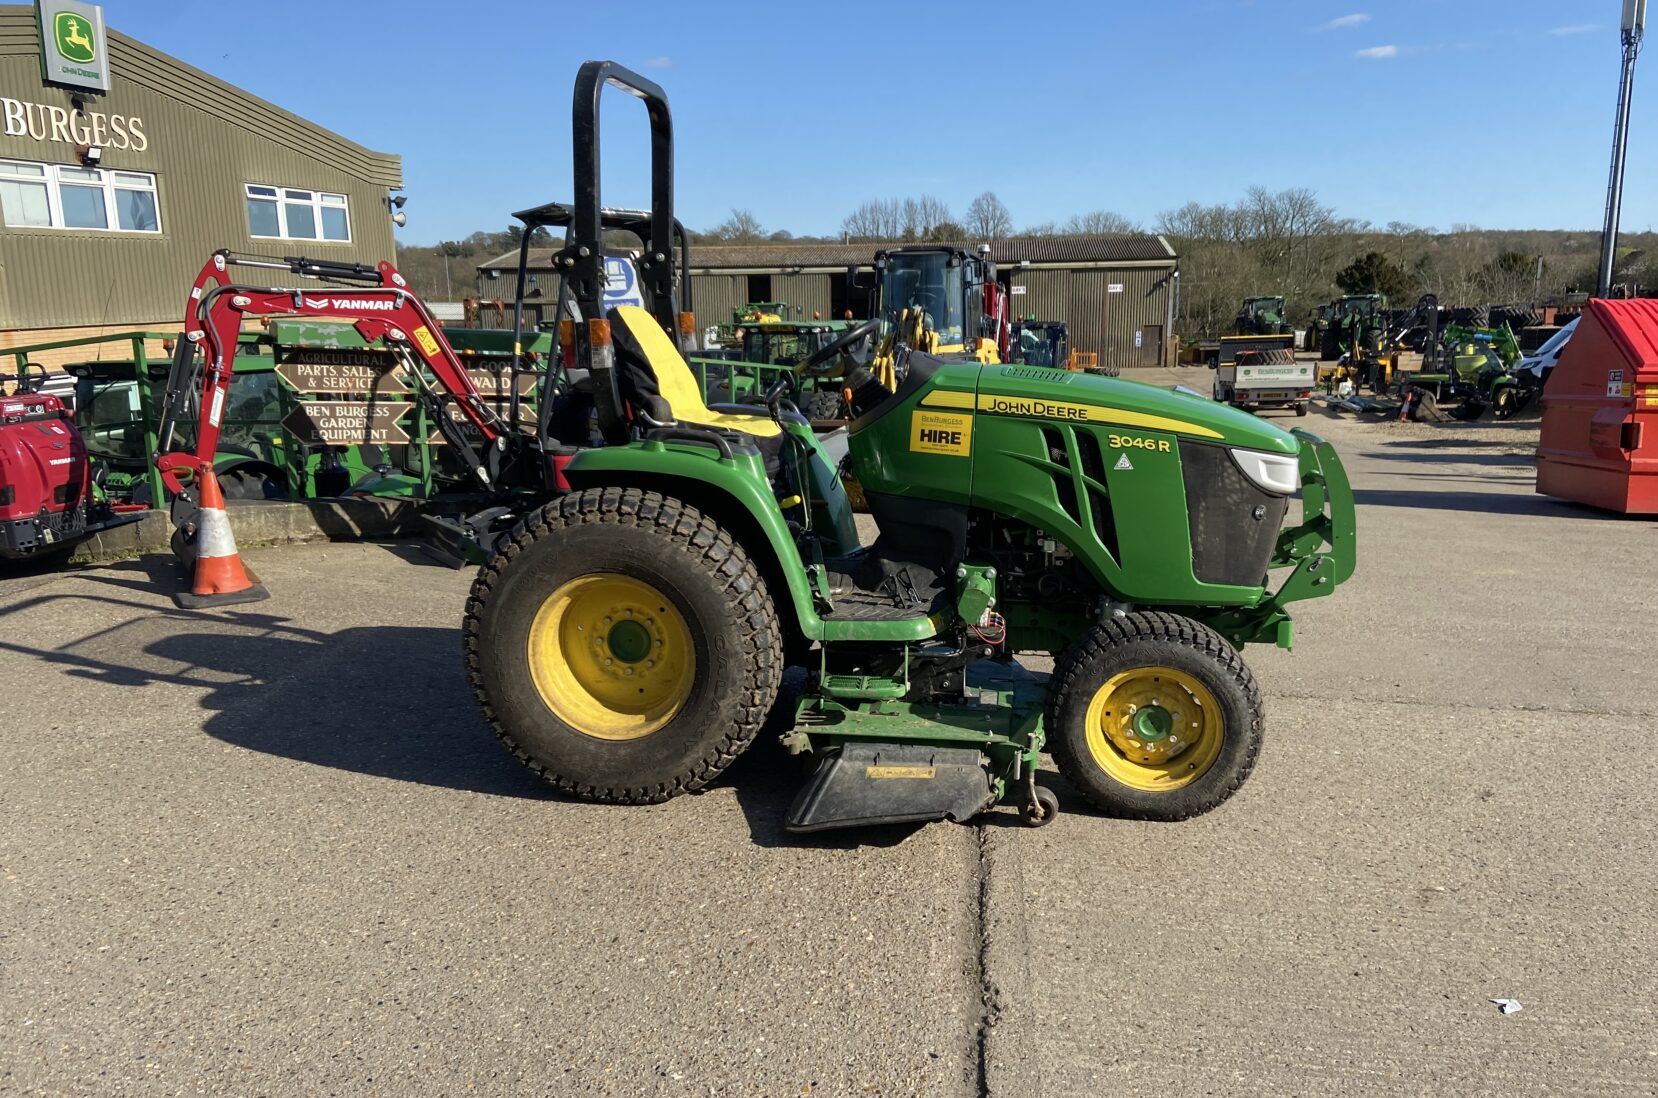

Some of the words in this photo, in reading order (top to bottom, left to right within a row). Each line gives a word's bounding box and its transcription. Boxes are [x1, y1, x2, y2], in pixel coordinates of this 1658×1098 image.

[0, 97, 148, 152] BURGESS
[332, 299, 394, 311] YANMAR
[298, 352, 387, 366] AGRICULTURAL
[347, 366, 382, 379] SALES
[308, 377, 318, 388] &
[323, 378, 375, 390] SERVICE
[306, 406, 332, 417] BEN
[338, 406, 390, 418] BURGESS
[988, 399, 1031, 415] JOHN
[1033, 402, 1088, 419] DEERE
[320, 418, 375, 430] GARDEN
[312, 430, 388, 442] EQUIPMENT
[920, 429, 962, 446] HIRE
[50, 457, 76, 466] YANMAR
